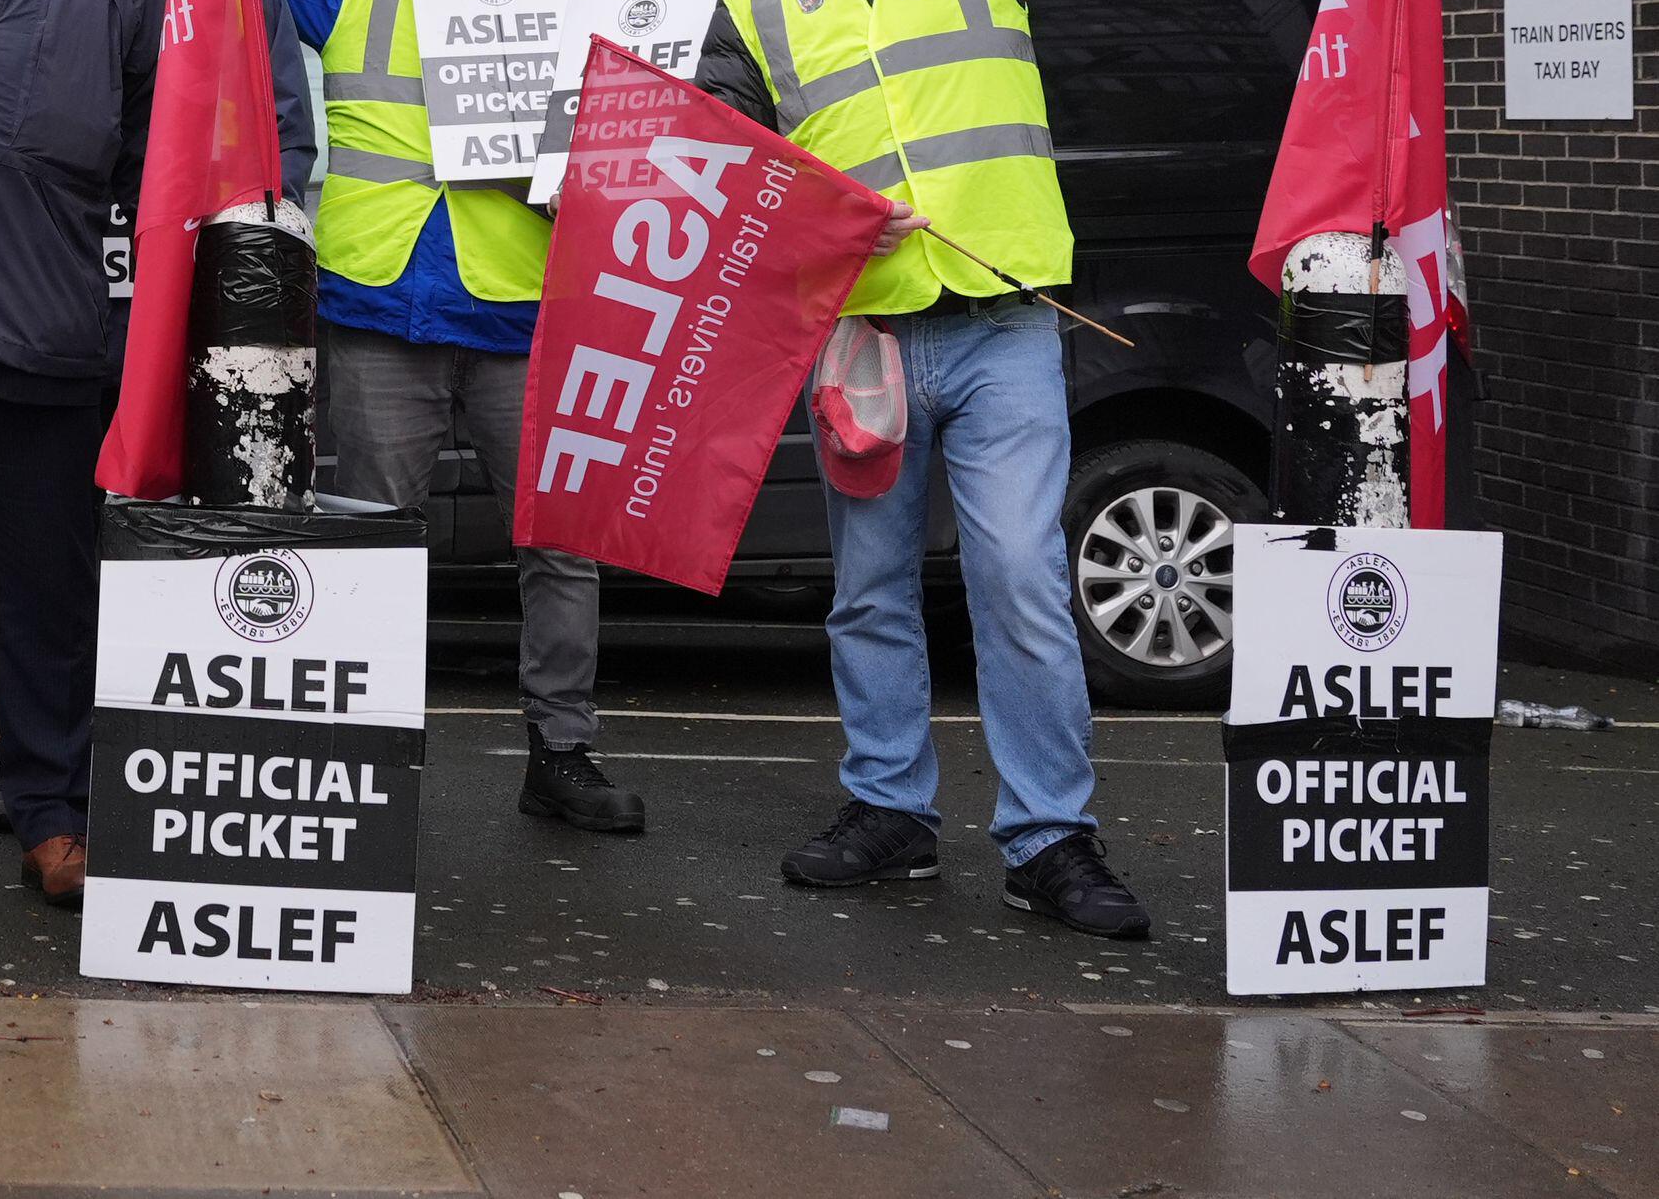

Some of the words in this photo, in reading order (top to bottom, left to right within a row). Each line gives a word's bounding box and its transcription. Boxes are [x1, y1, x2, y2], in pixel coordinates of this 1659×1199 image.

[445, 12, 558, 45] ASLEF
[1510, 25, 1554, 44] TRAIN
[1558, 21, 1626, 43] DRIVERS
[439, 60, 556, 85] OFFICIA
[1534, 62, 1566, 80] TAXI
[1571, 60, 1600, 79] BAY
[456, 90, 553, 114] PICKE
[1349, 555, 1388, 570] ASLEF
[276, 611, 304, 636] 1880
[1377, 619, 1402, 645] 1880
[150, 652, 369, 713] ASLEF
[1279, 665, 1453, 717] ASLEF
[125, 748, 388, 804] OFFICIAL
[1256, 760, 1467, 805] OFFICIAL
[152, 809, 357, 861] PICKET
[1282, 818, 1444, 862] PICKET
[137, 901, 358, 962] ASLEF
[1276, 907, 1445, 964] ASLEF
